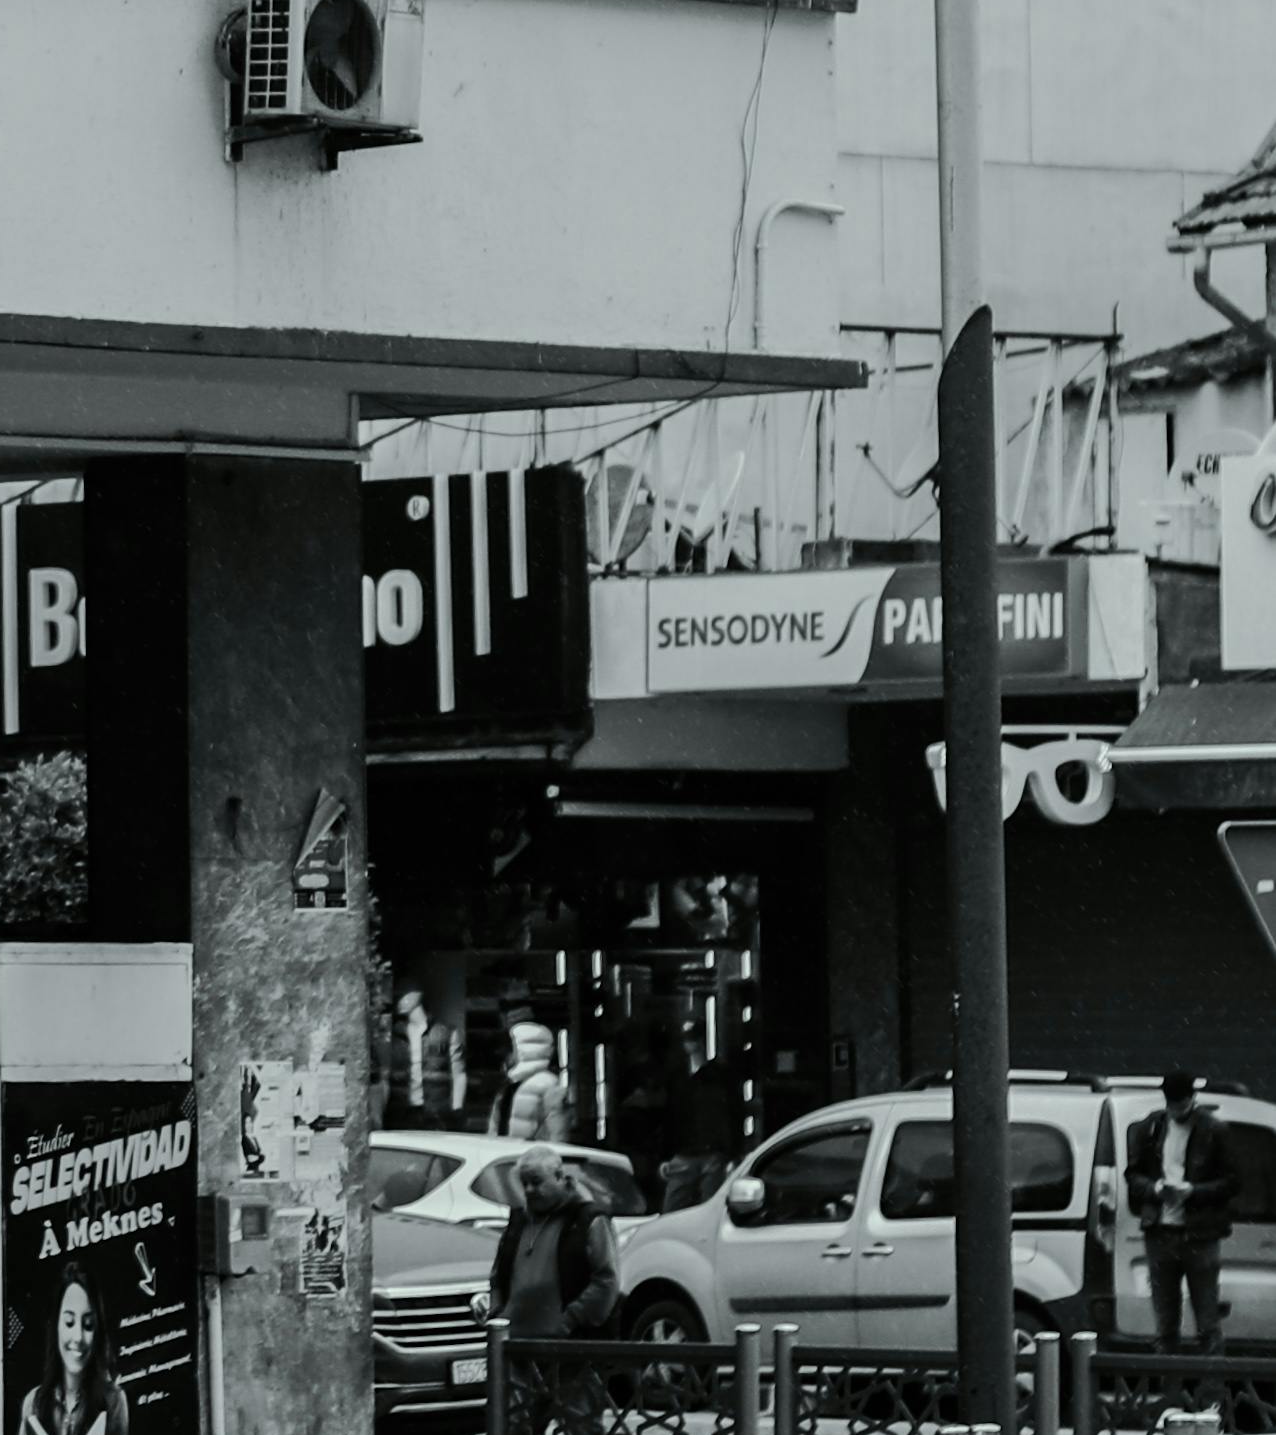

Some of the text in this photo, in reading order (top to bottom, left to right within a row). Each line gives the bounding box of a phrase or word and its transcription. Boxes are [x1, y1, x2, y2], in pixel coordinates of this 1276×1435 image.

[656, 611, 824, 648] SENSODYNE
[27, 1123, 75, 1159] Étudier
[10, 1119, 191, 1215] SELECTIVIDAD
[38, 1202, 164, 1260] À Meknes
